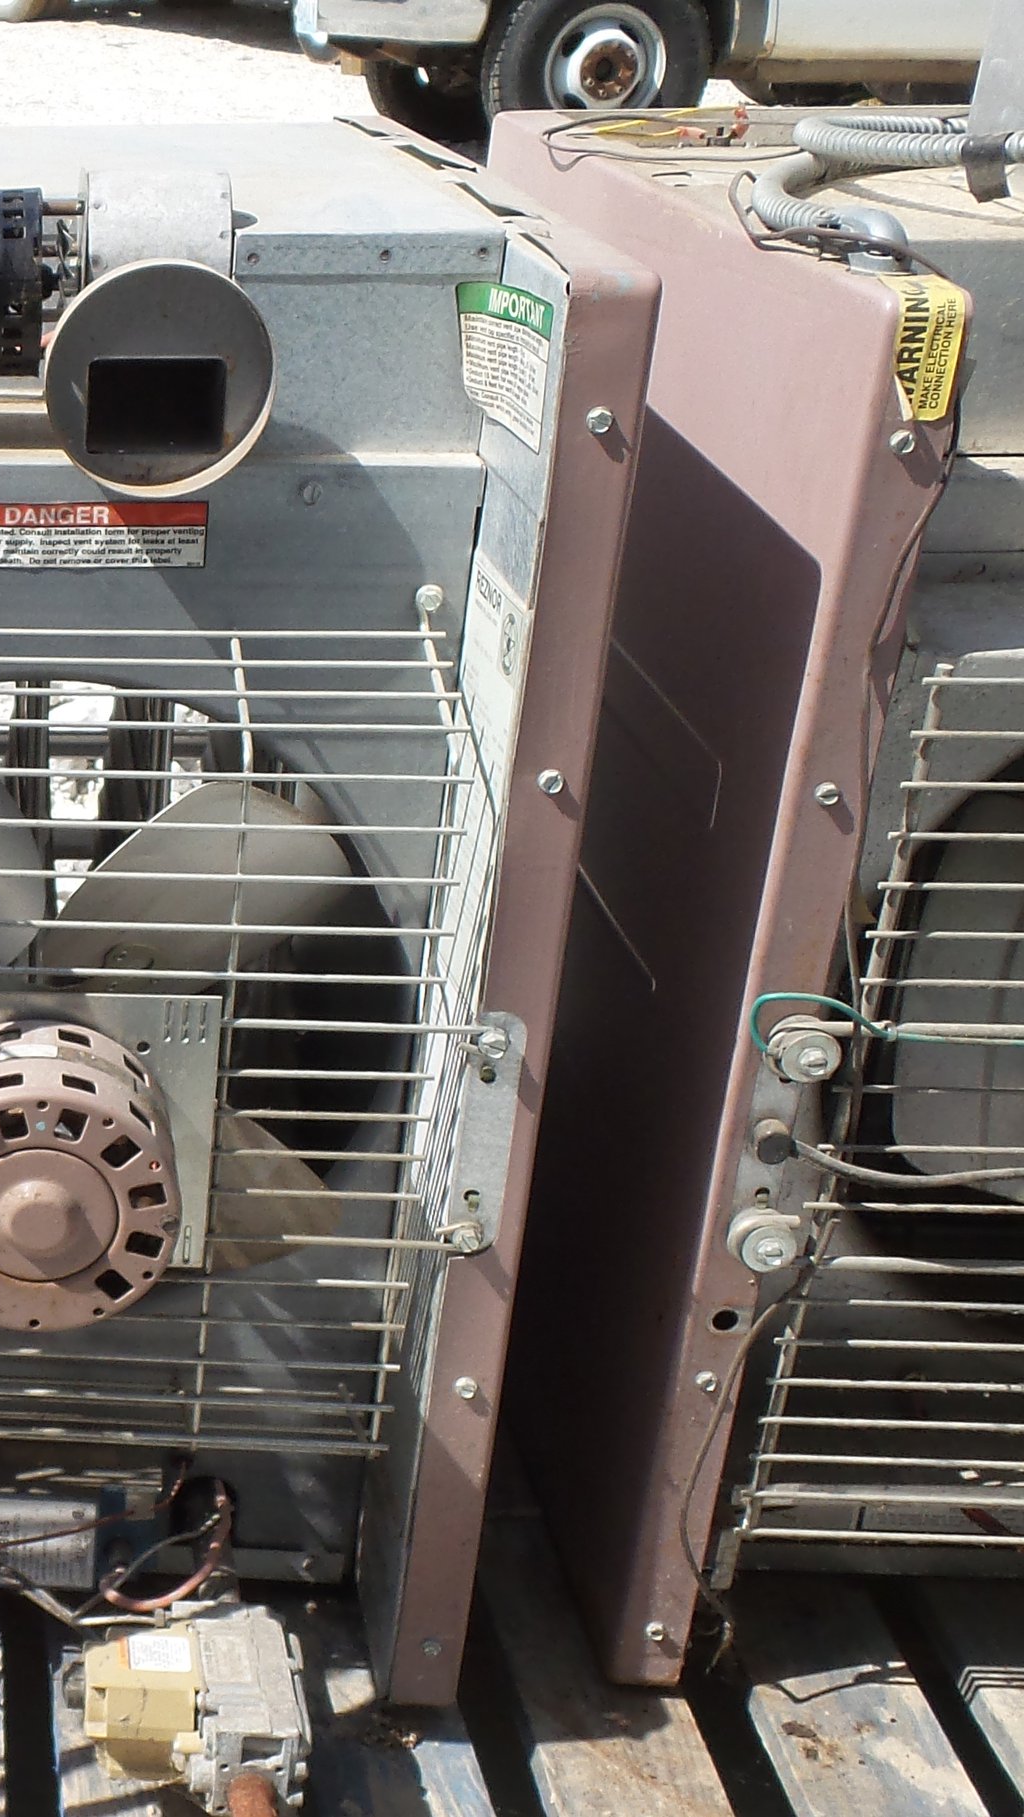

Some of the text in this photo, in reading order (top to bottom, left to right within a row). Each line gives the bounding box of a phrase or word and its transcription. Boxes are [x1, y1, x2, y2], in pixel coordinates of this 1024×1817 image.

[488, 287, 545, 329] IMPORTANT
[918, 302, 946, 409] MAKE ELECTRICAL
[928, 298, 957, 409] CONNECTION HERE
[4, 506, 110, 525] DANGER
[19, 528, 52, 536] Consult
[104, 528, 125, 536] form
[127, 528, 139, 536] for
[141, 528, 170, 538] proper
[172, 528, 205, 537] venting
[94, 538, 125, 547] system
[3, 547, 39, 555] maintain
[41, 547, 78, 557] correctly
[81, 547, 106, 555] could
[107, 547, 133, 555] result
[145, 547, 182, 556] property
[476, 569, 502, 615] REZNOR
